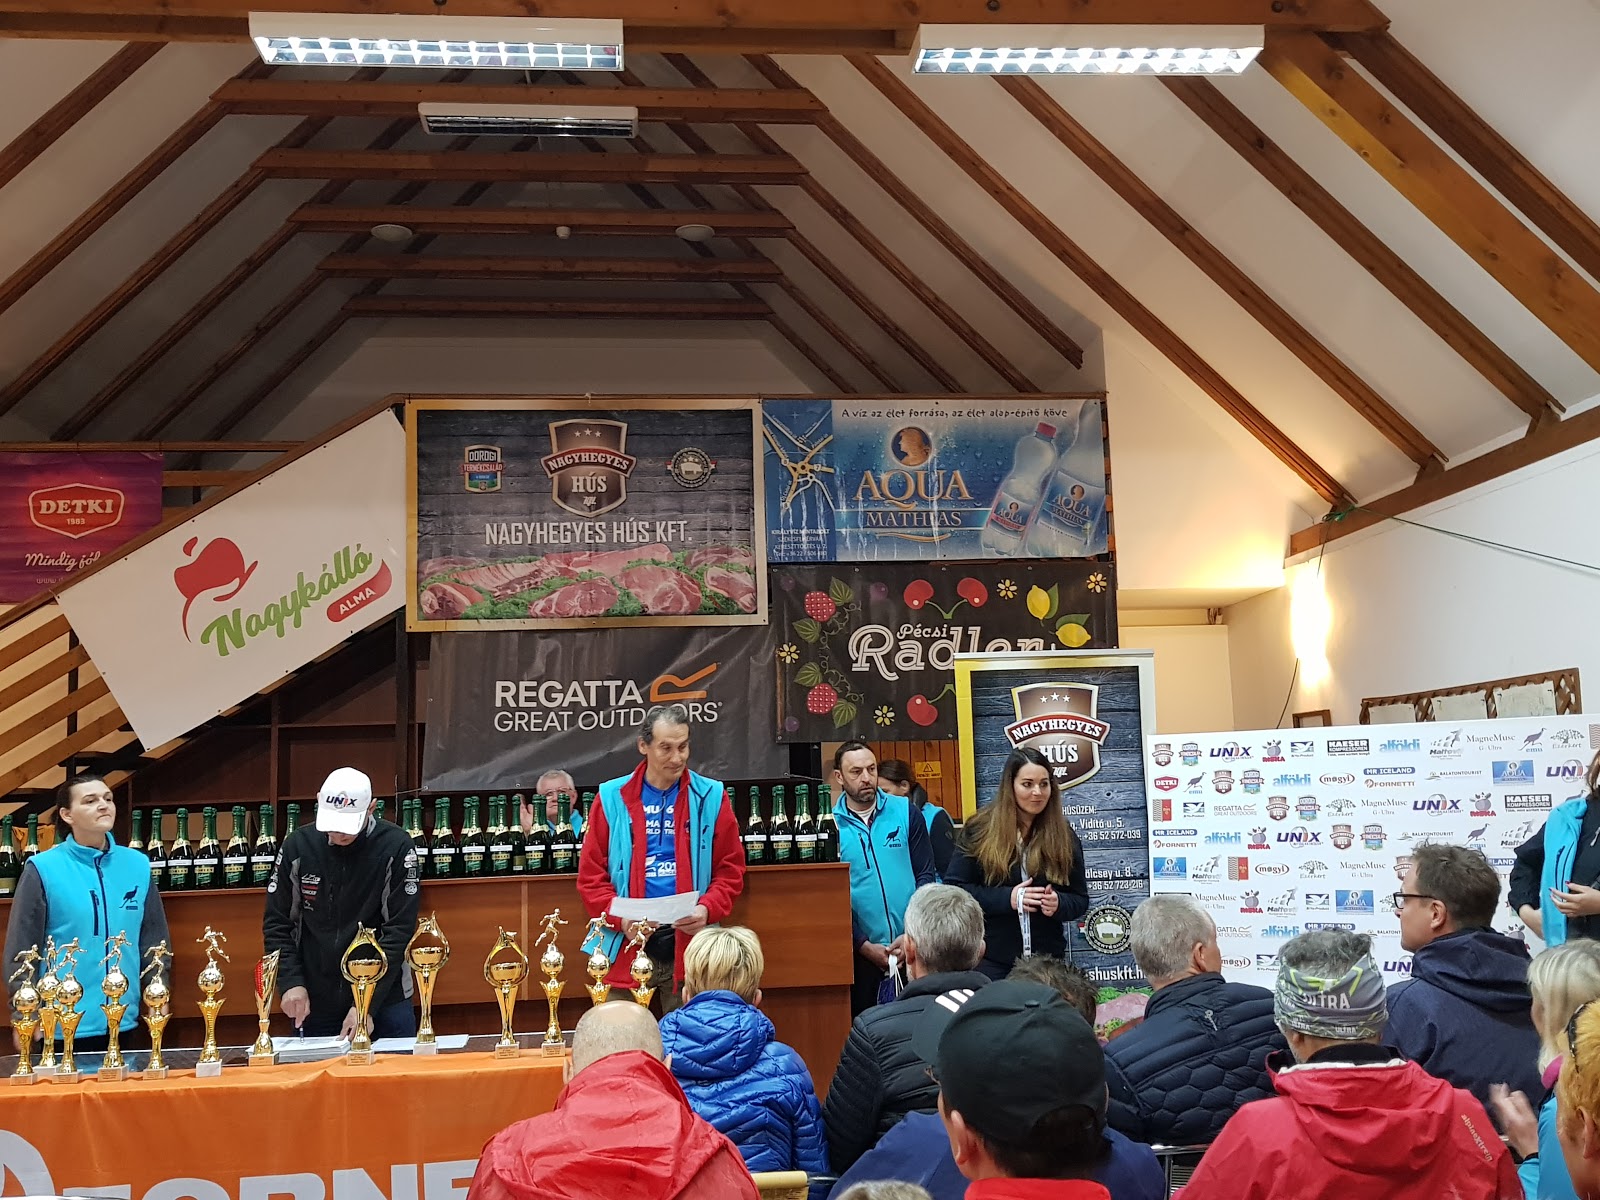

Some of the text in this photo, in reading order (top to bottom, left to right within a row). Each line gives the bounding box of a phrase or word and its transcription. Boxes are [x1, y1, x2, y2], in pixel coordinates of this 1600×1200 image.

[842, 409, 850, 418] A
[852, 409, 867, 418] víz
[871, 410, 882, 418] az
[886, 408, 905, 418] élet
[909, 408, 948, 420] forrása,
[952, 410, 963, 418] az
[966, 408, 986, 418] élet
[1044, 408, 1067, 418] köve
[547, 452, 630, 471] NAGYHEGYES
[571, 471, 607, 493] HÚS
[853, 469, 974, 509] AQUA
[39, 499, 114, 514] DETKI
[1053, 493, 1090, 517] AQUA
[66, 517, 86, 525] 1983
[866, 510, 962, 528] MATHIAS
[485, 520, 693, 545] NAGYHEGYES HÚS KFT.
[25, 551, 77, 572] Mindig
[200, 543, 373, 657] Nagykálló
[339, 587, 376, 615] ALMA
[896, 623, 947, 639] Pécsi
[495, 679, 644, 708] REGATTA
[494, 711, 573, 732] GREAT
[1011, 719, 1103, 741] NAGYHEGYES
[1328, 740, 1368, 748] KAESER
[1379, 738, 1420, 752] alföldi
[1038, 740, 1079, 763] HÚS
[1210, 746, 1252, 757] UNIX
[1546, 766, 1585, 777] UNI
[1273, 773, 1311, 787] alföldi
[1323, 775, 1351, 784] mogyi
[326, 795, 358, 807] UNIX
[1412, 799, 1462, 811] UNIX
[643, 805, 660, 814] MU
[1116, 817, 1125, 828] 5.
[1083, 830, 1141, 840] +36 52 572-039
[1204, 831, 1241, 845] alföldi
[1276, 832, 1322, 843] UNIX
[1085, 866, 1134, 880] ölcsey u. 8.
[1259, 864, 1286, 874] mogyi
[1088, 881, 1103, 890] +36
[1104, 880, 1114, 890] 52
[1261, 924, 1300, 938] alföldi
[1086, 965, 1147, 981] shuskft.h
